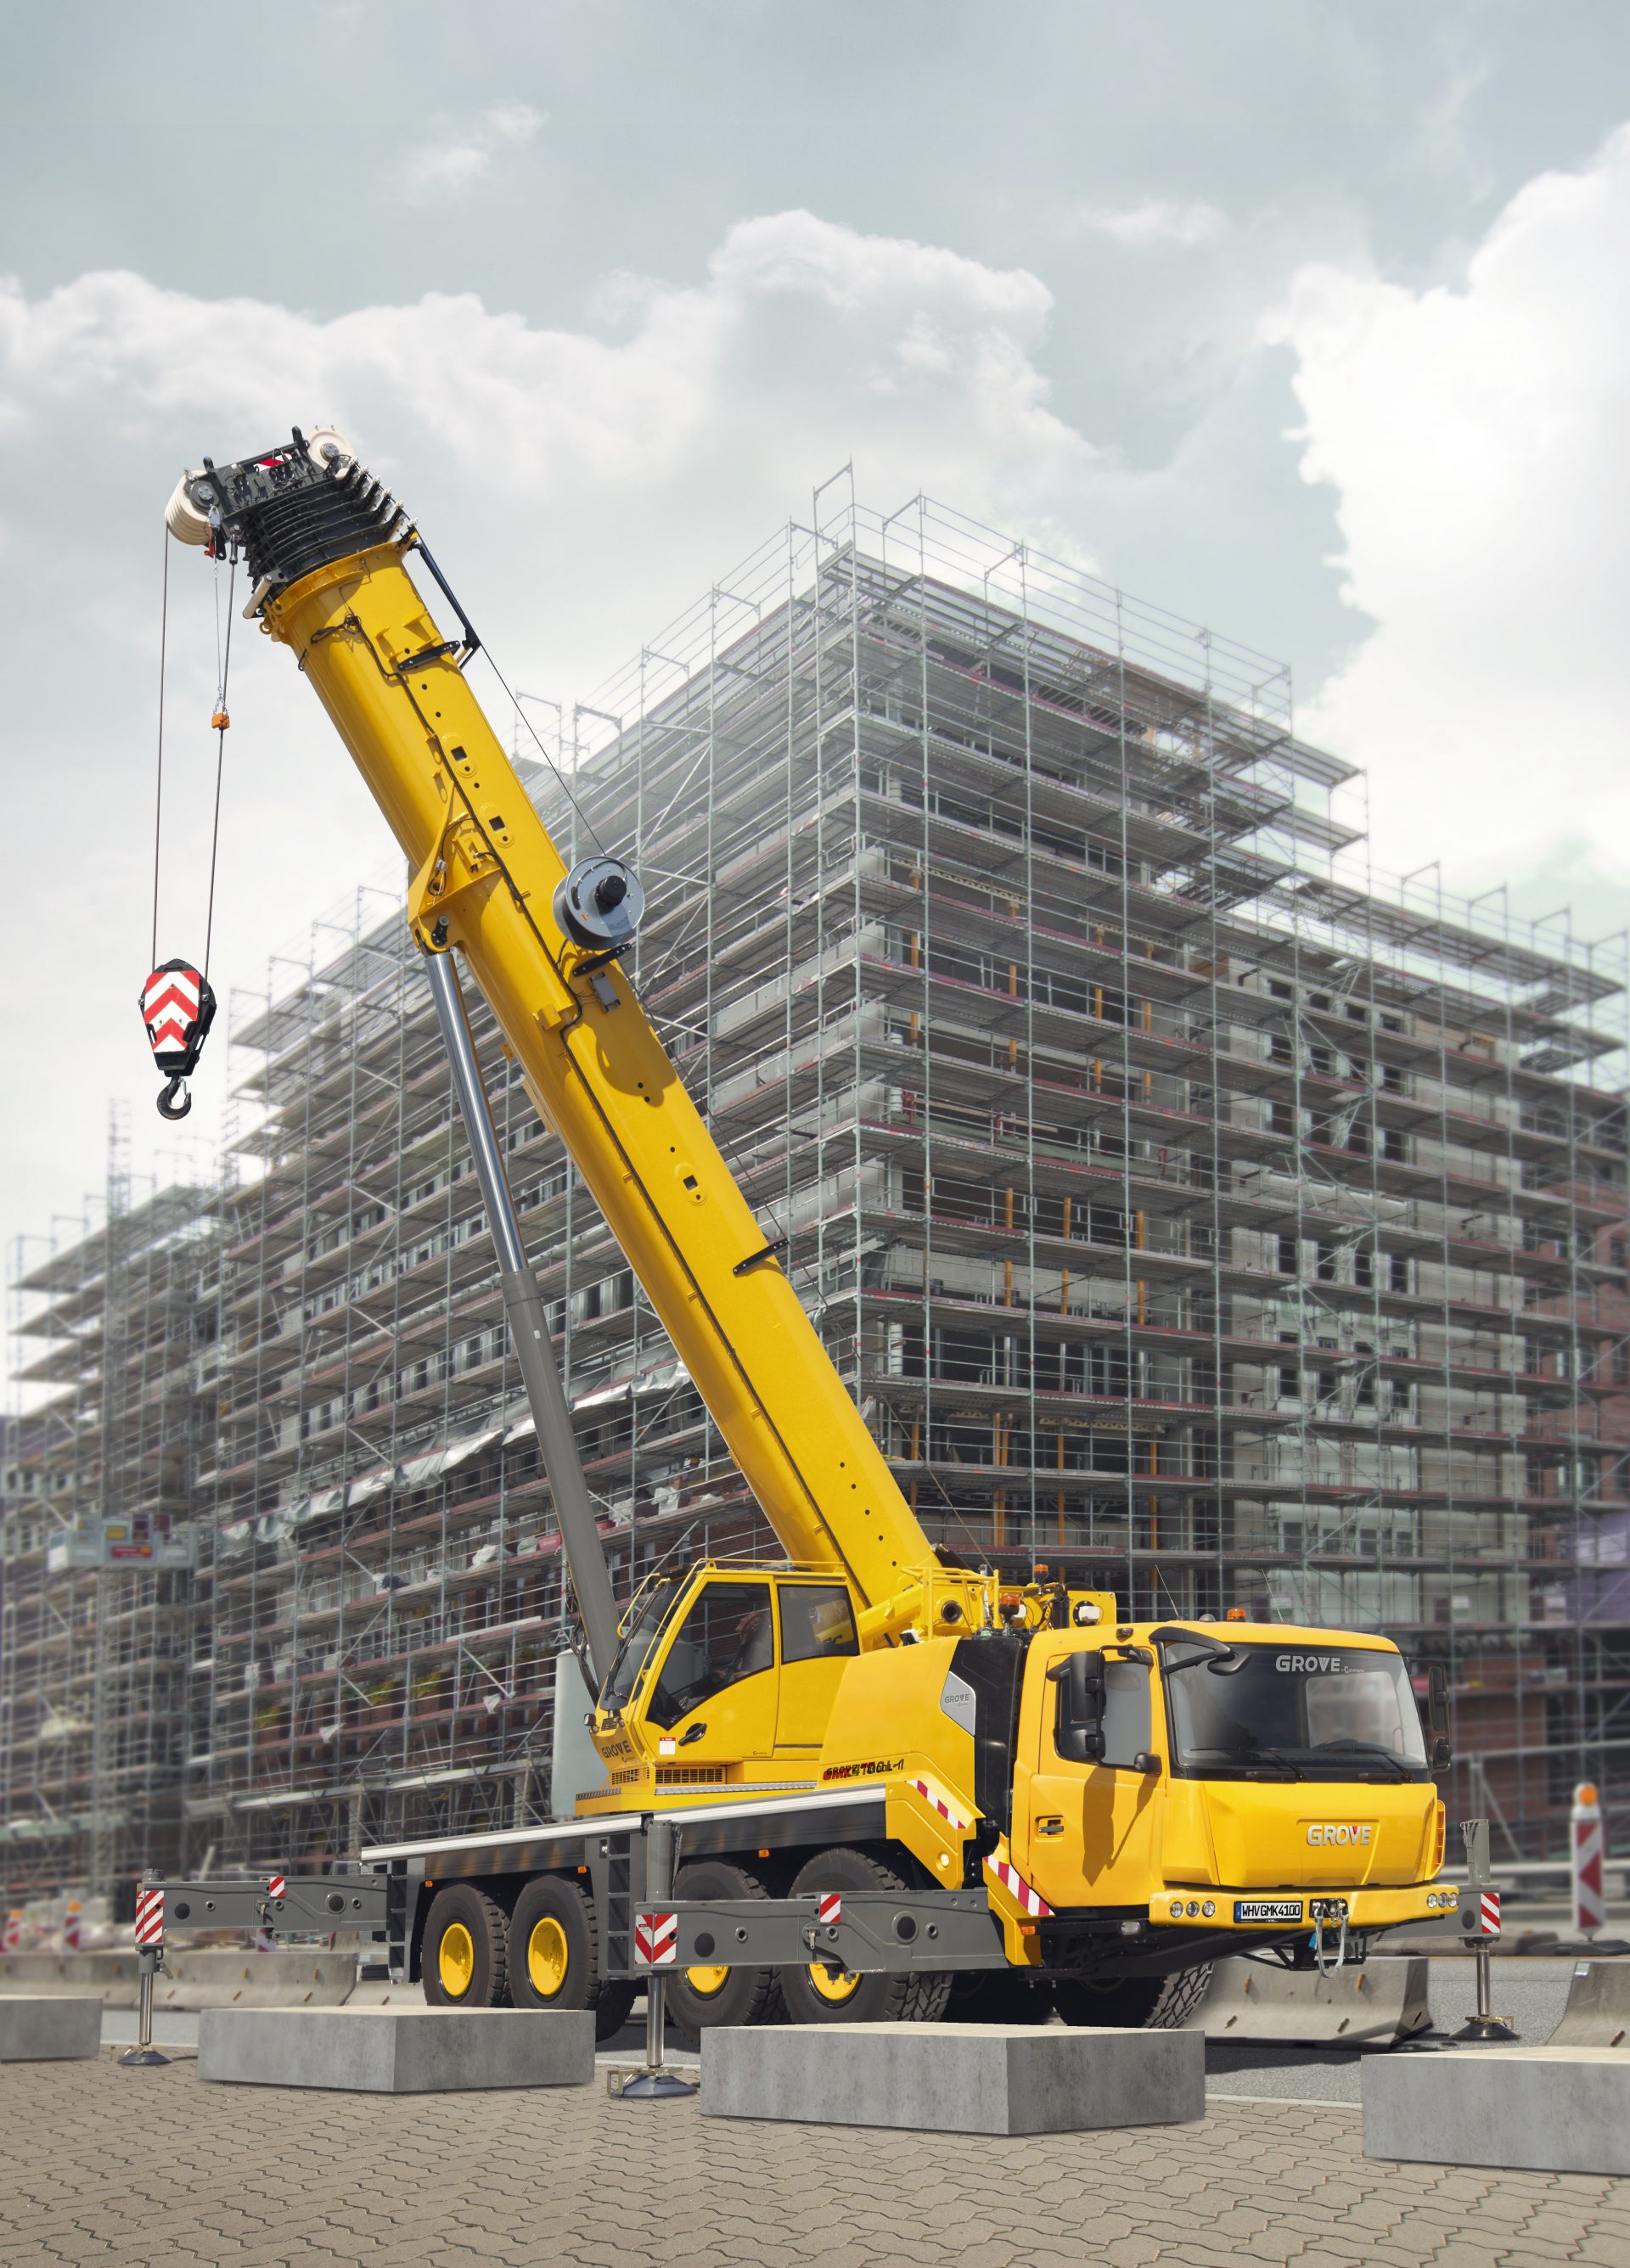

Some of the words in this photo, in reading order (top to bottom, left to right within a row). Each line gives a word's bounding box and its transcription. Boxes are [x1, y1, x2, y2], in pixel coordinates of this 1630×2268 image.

[1275, 1654, 1341, 1672] GROVE
[944, 1693, 970, 1704] GROVE
[601, 1740, 632, 1759] GROVE
[1307, 1825, 1372, 1846] GROVE
